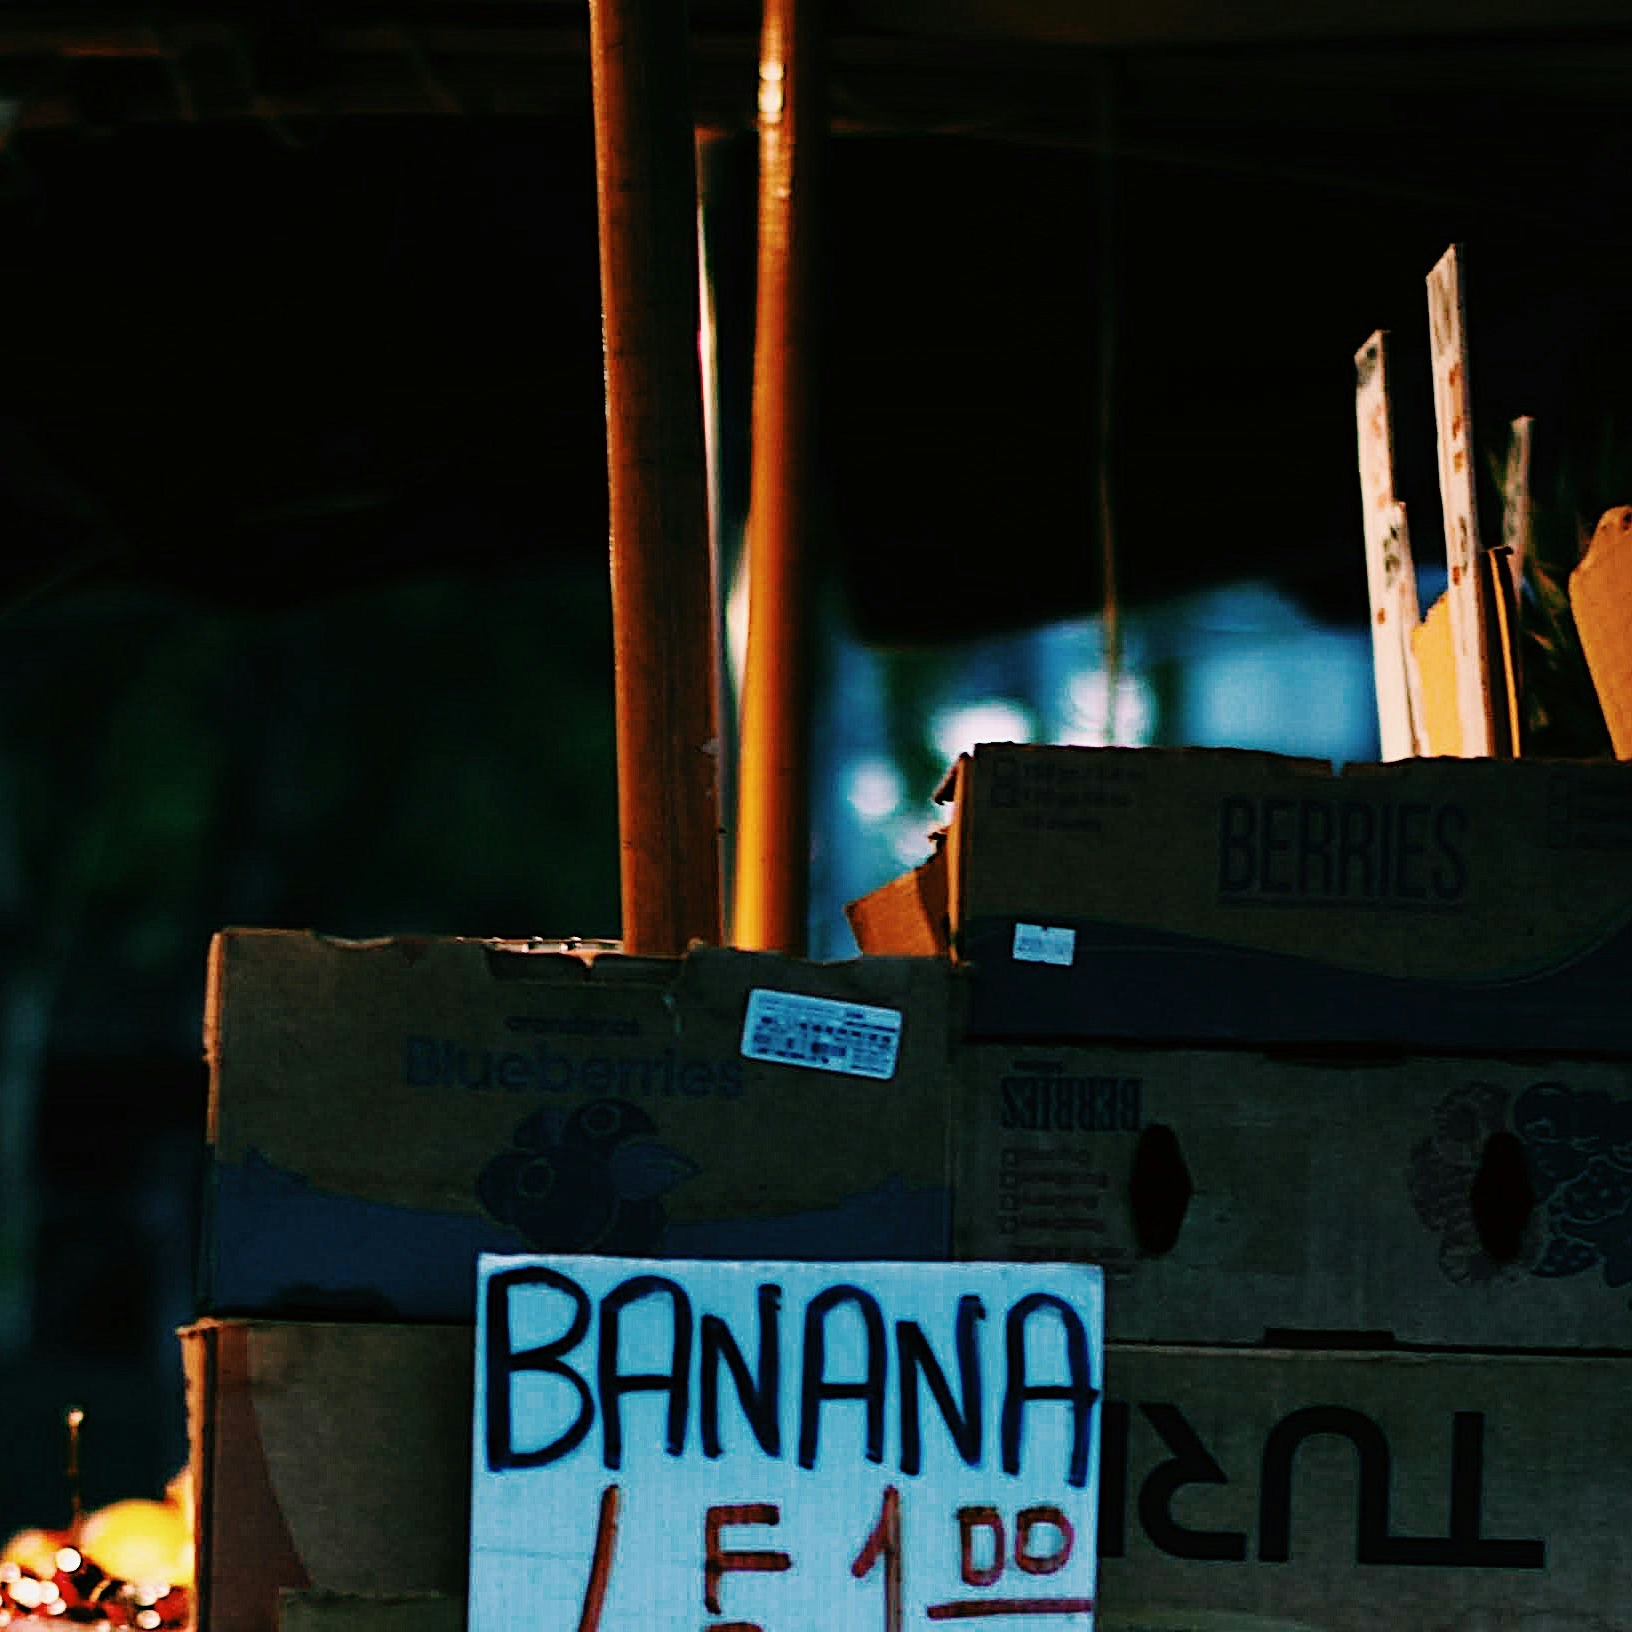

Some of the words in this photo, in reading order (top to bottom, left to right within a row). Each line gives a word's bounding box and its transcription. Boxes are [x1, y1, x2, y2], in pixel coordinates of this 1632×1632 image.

[1218, 795, 1469, 900] BERRIES
[402, 1035, 747, 1098] Blueberries
[1000, 1076, 1143, 1131] BERRIES
[485, 1266, 1099, 1488] BANANA
